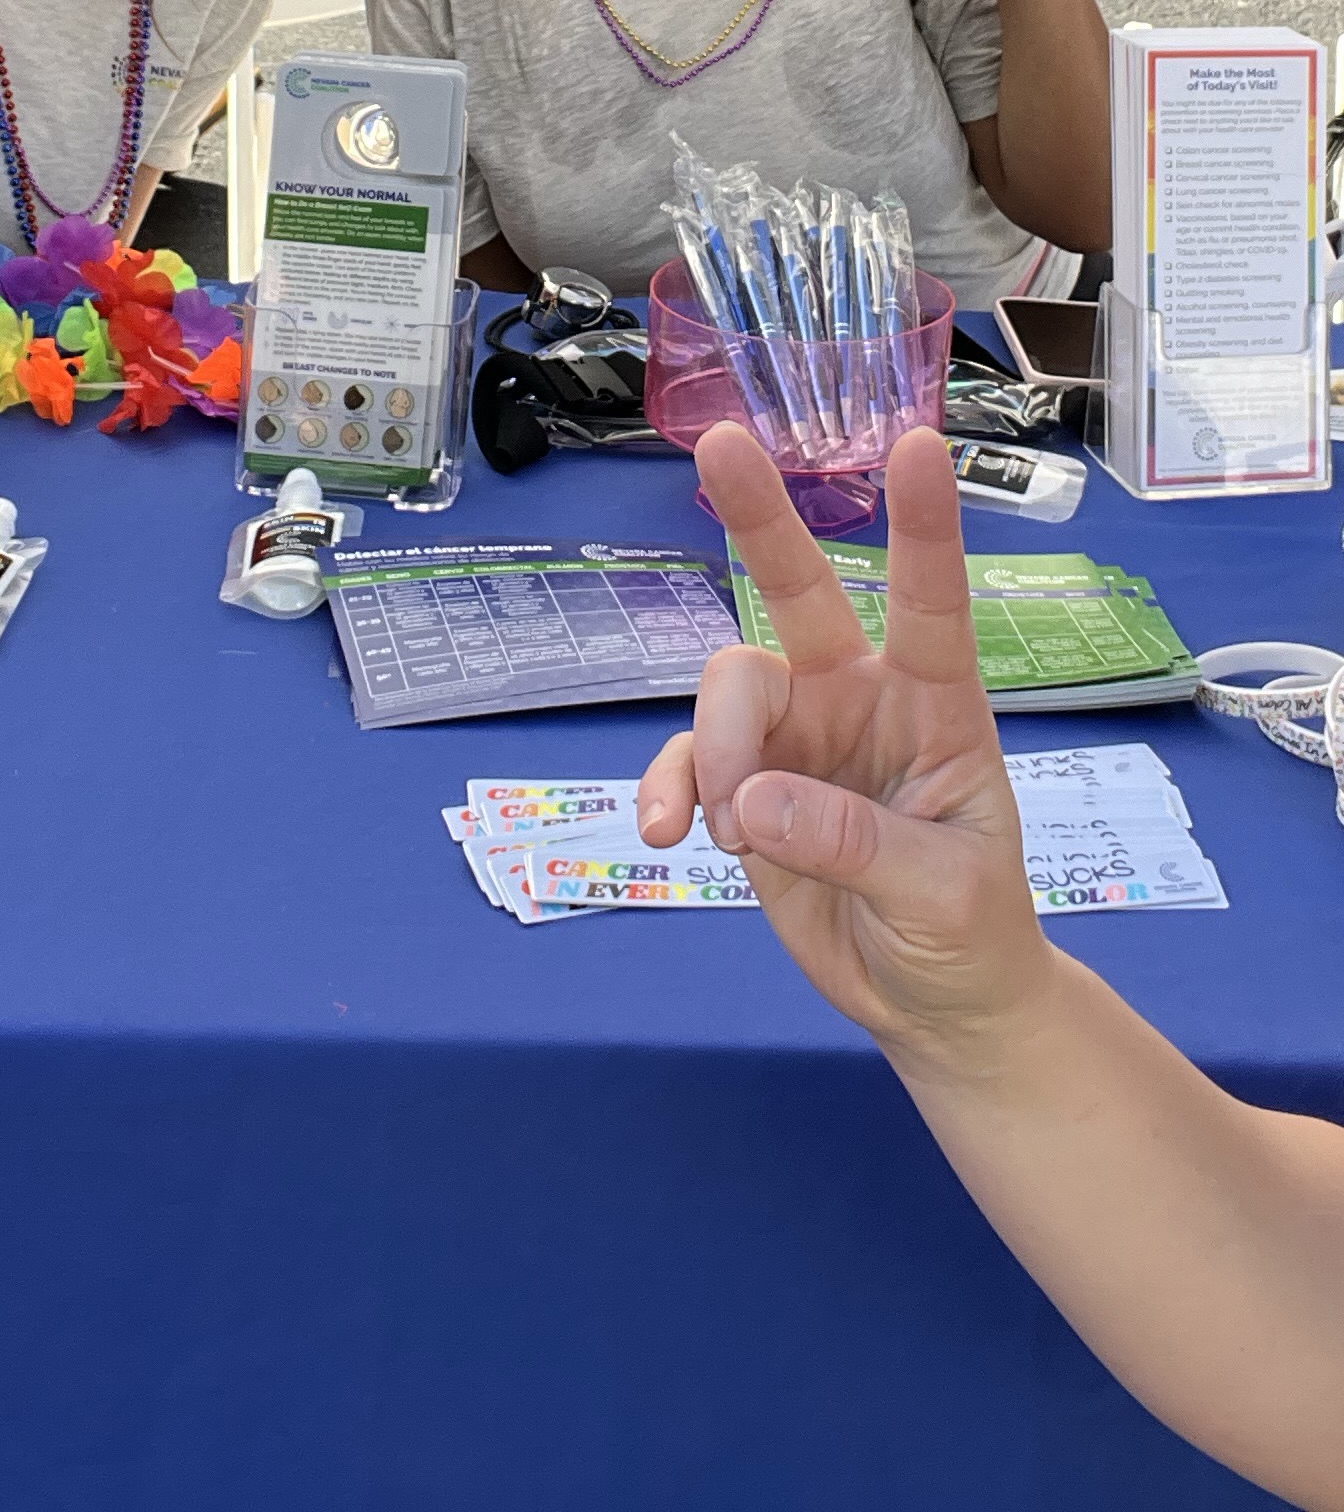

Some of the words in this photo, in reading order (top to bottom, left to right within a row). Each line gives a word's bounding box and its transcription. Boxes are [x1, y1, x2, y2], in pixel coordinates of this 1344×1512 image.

[1189, 68, 1222, 79] Make
[1223, 68, 1244, 78] the
[1246, 67, 1276, 78] Most
[1186, 80, 1201, 91] of
[1201, 80, 1247, 93] Today's
[1247, 79, 1279, 90] Visit!
[275, 181, 318, 195] KNOW
[318, 185, 354, 198] YOUR
[356, 188, 412, 203] NORMAL
[316, 364, 359, 376] CHANGES
[360, 367, 372, 377] TO
[373, 369, 398, 380] NOTE
[333, 548, 404, 561] Detectar
[477, 543, 553, 553] temprano
[833, 553, 871, 568] Early
[499, 797, 618, 820] CANCER
[546, 859, 670, 881] CANCER
[686, 865, 748, 885] SUC
[1029, 859, 1136, 891] SUCKS
[546, 880, 580, 898] IN
[585, 882, 697, 901] EVERY
[700, 884, 758, 901] COL
[1047, 882, 1150, 907] COLOR
